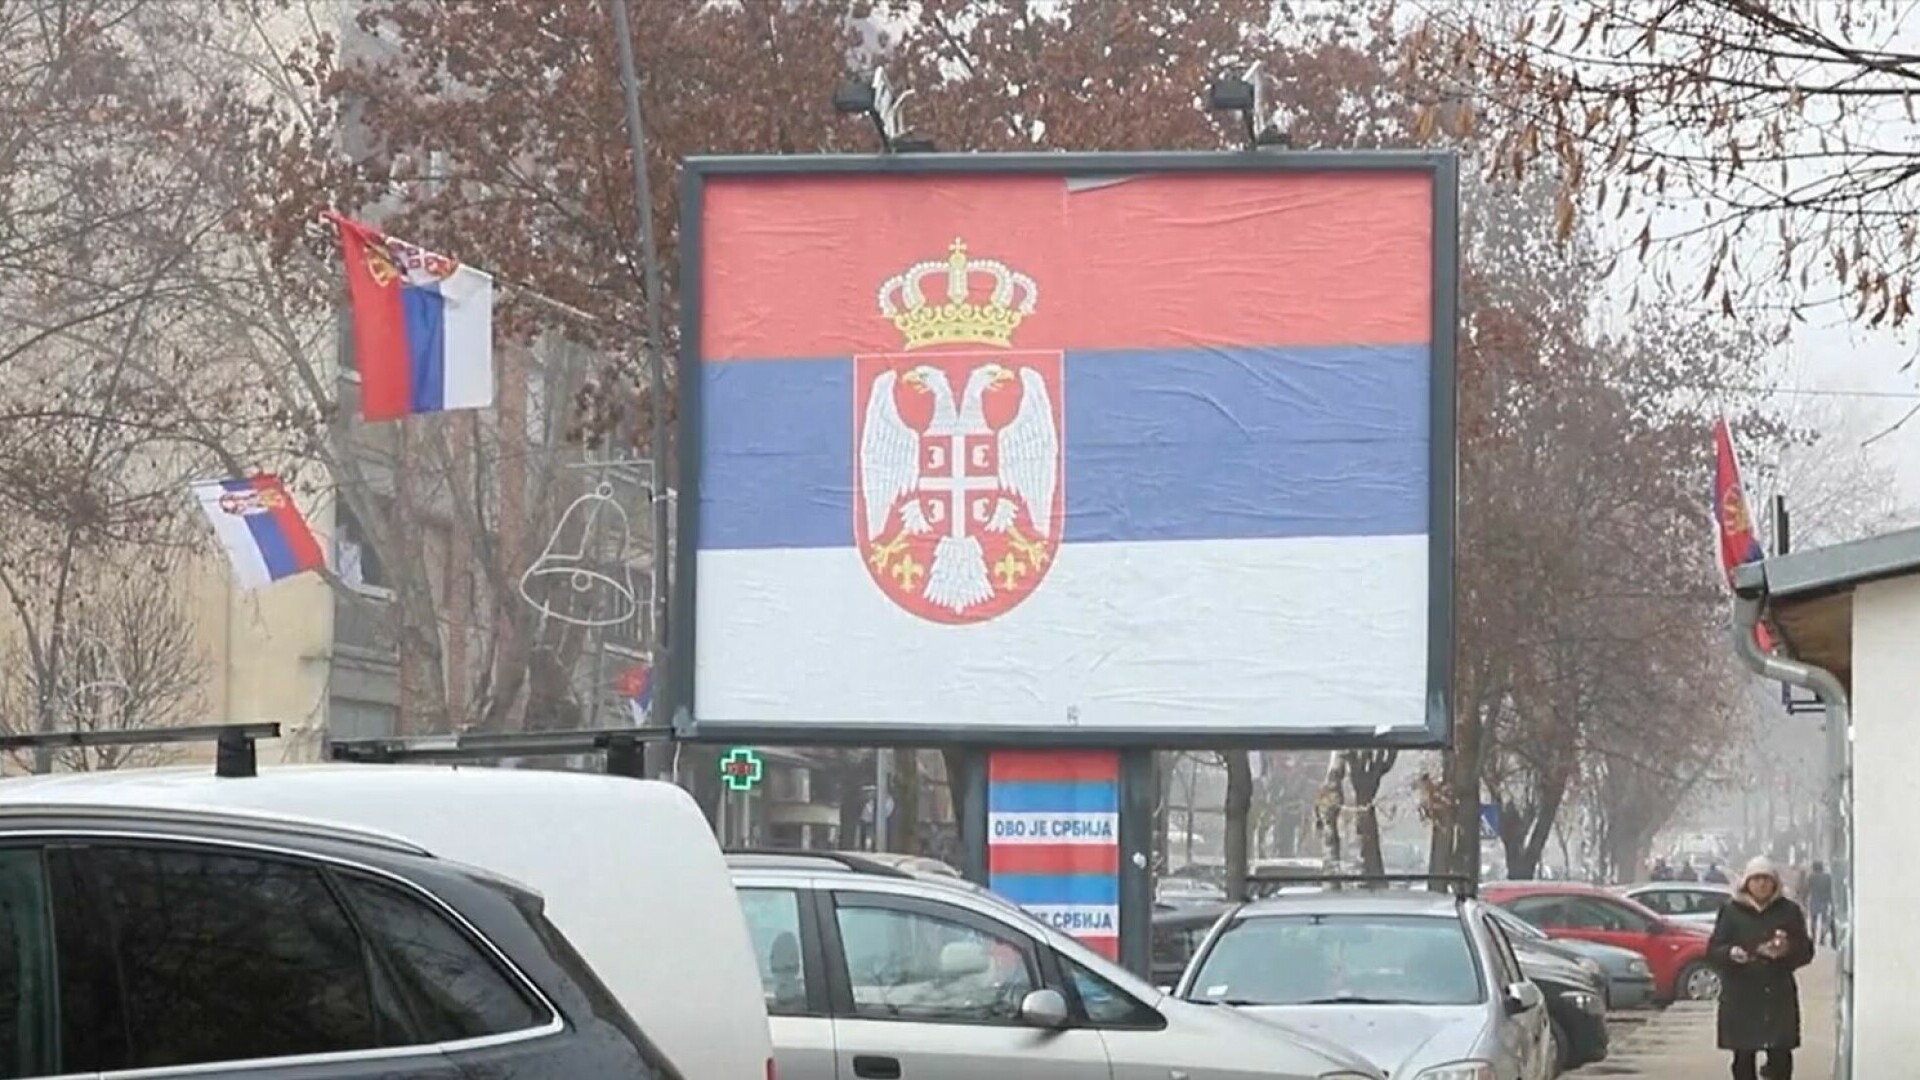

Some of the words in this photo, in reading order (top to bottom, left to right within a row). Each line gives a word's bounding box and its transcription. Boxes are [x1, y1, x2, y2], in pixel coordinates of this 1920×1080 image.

[995, 820, 1025, 836] ОВО
[1029, 820, 1048, 836] ЈЕ
[1052, 820, 1112, 836] СРБИЈА
[1053, 912, 1112, 928] СРБИЈА
